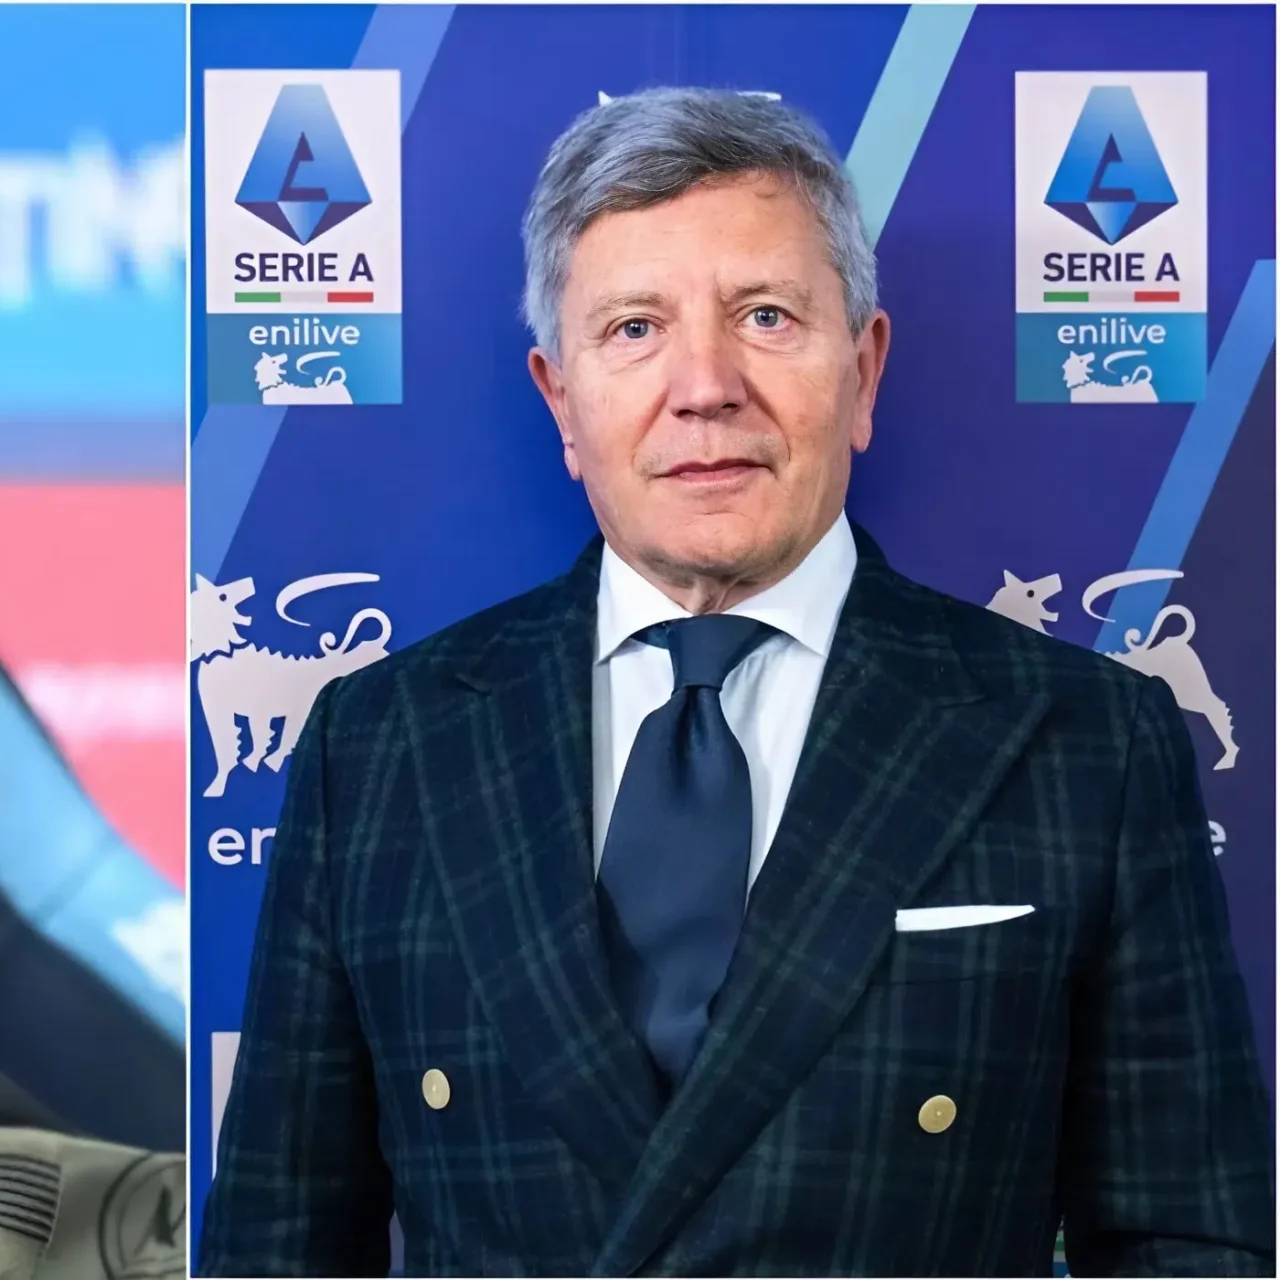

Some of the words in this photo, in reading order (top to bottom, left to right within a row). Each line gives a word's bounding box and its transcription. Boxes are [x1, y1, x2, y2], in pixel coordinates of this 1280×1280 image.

[234, 252, 338, 283] SERIE
[348, 252, 375, 282] A
[1043, 252, 1145, 283] SERIE
[1155, 252, 1180, 282] A
[248, 317, 361, 346] enilive
[1056, 317, 1167, 345] enilive
